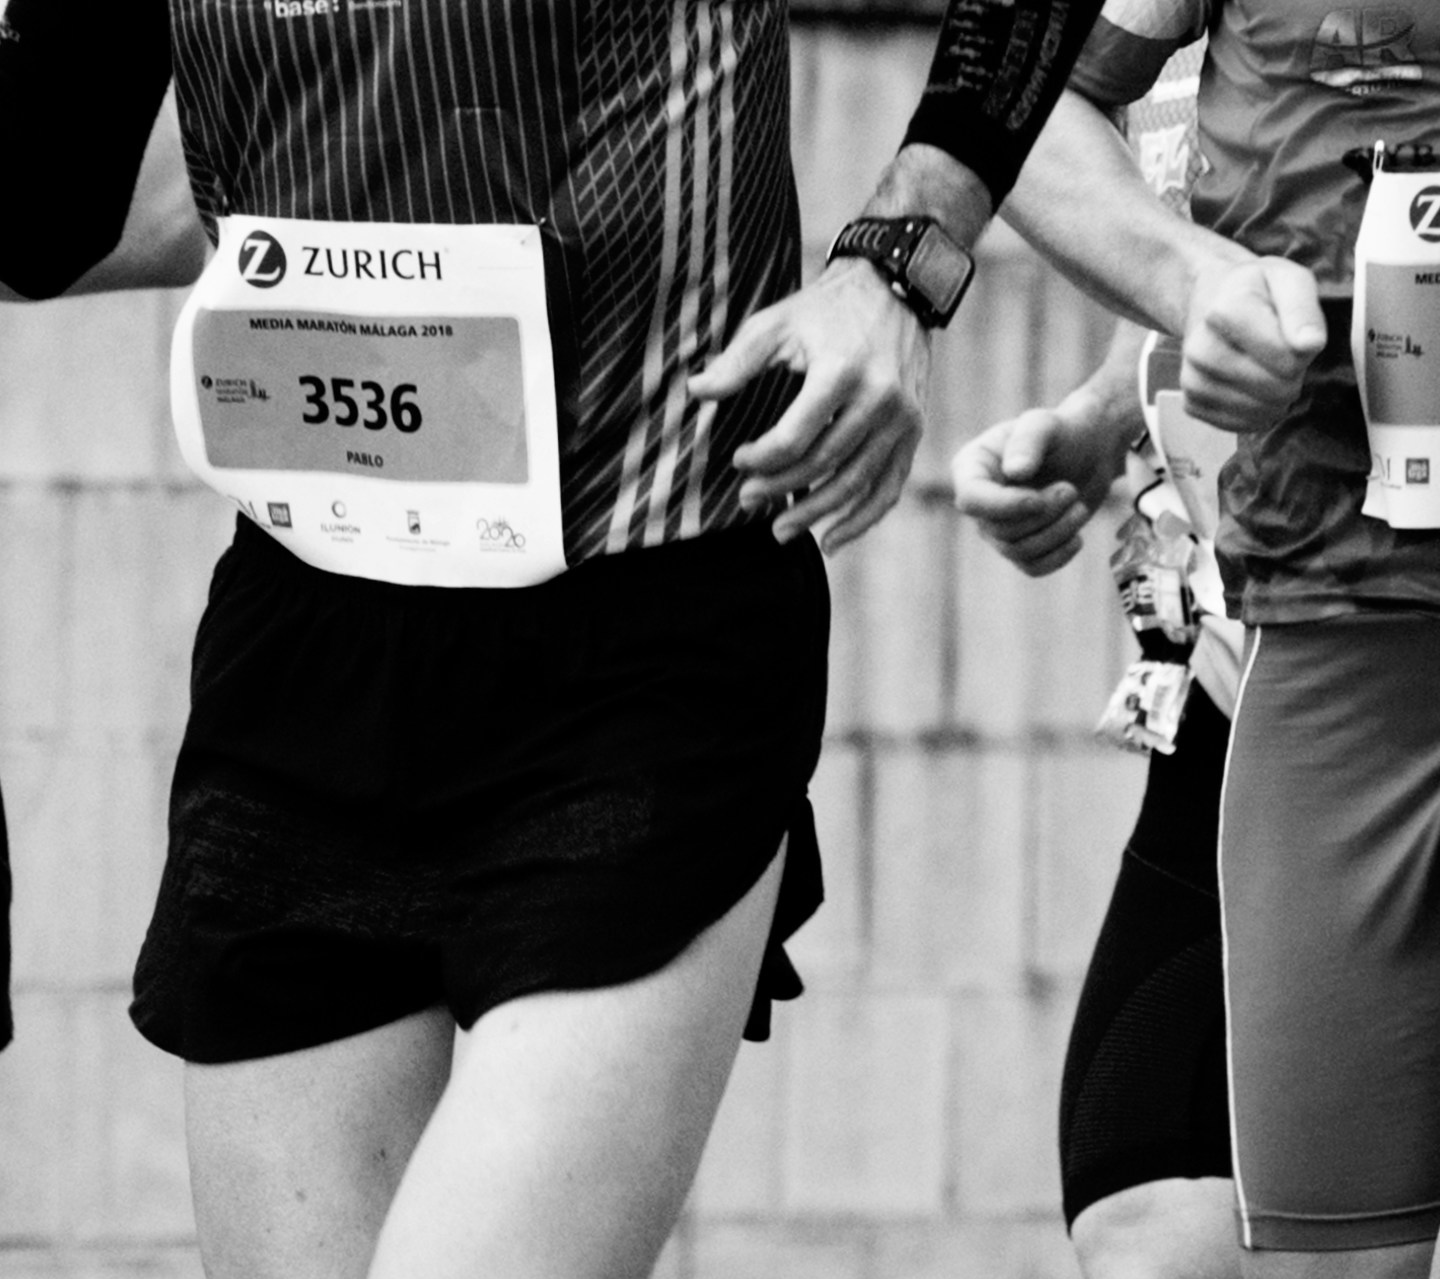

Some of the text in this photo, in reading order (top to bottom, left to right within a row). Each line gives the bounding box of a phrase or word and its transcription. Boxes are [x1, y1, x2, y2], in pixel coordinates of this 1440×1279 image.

[302, 245, 444, 281] ZURICH
[249, 317, 454, 338] MEDIA MARATÓN MÁLAGA 2018
[298, 374, 423, 434] 3536
[346, 449, 385, 469] PABLO
